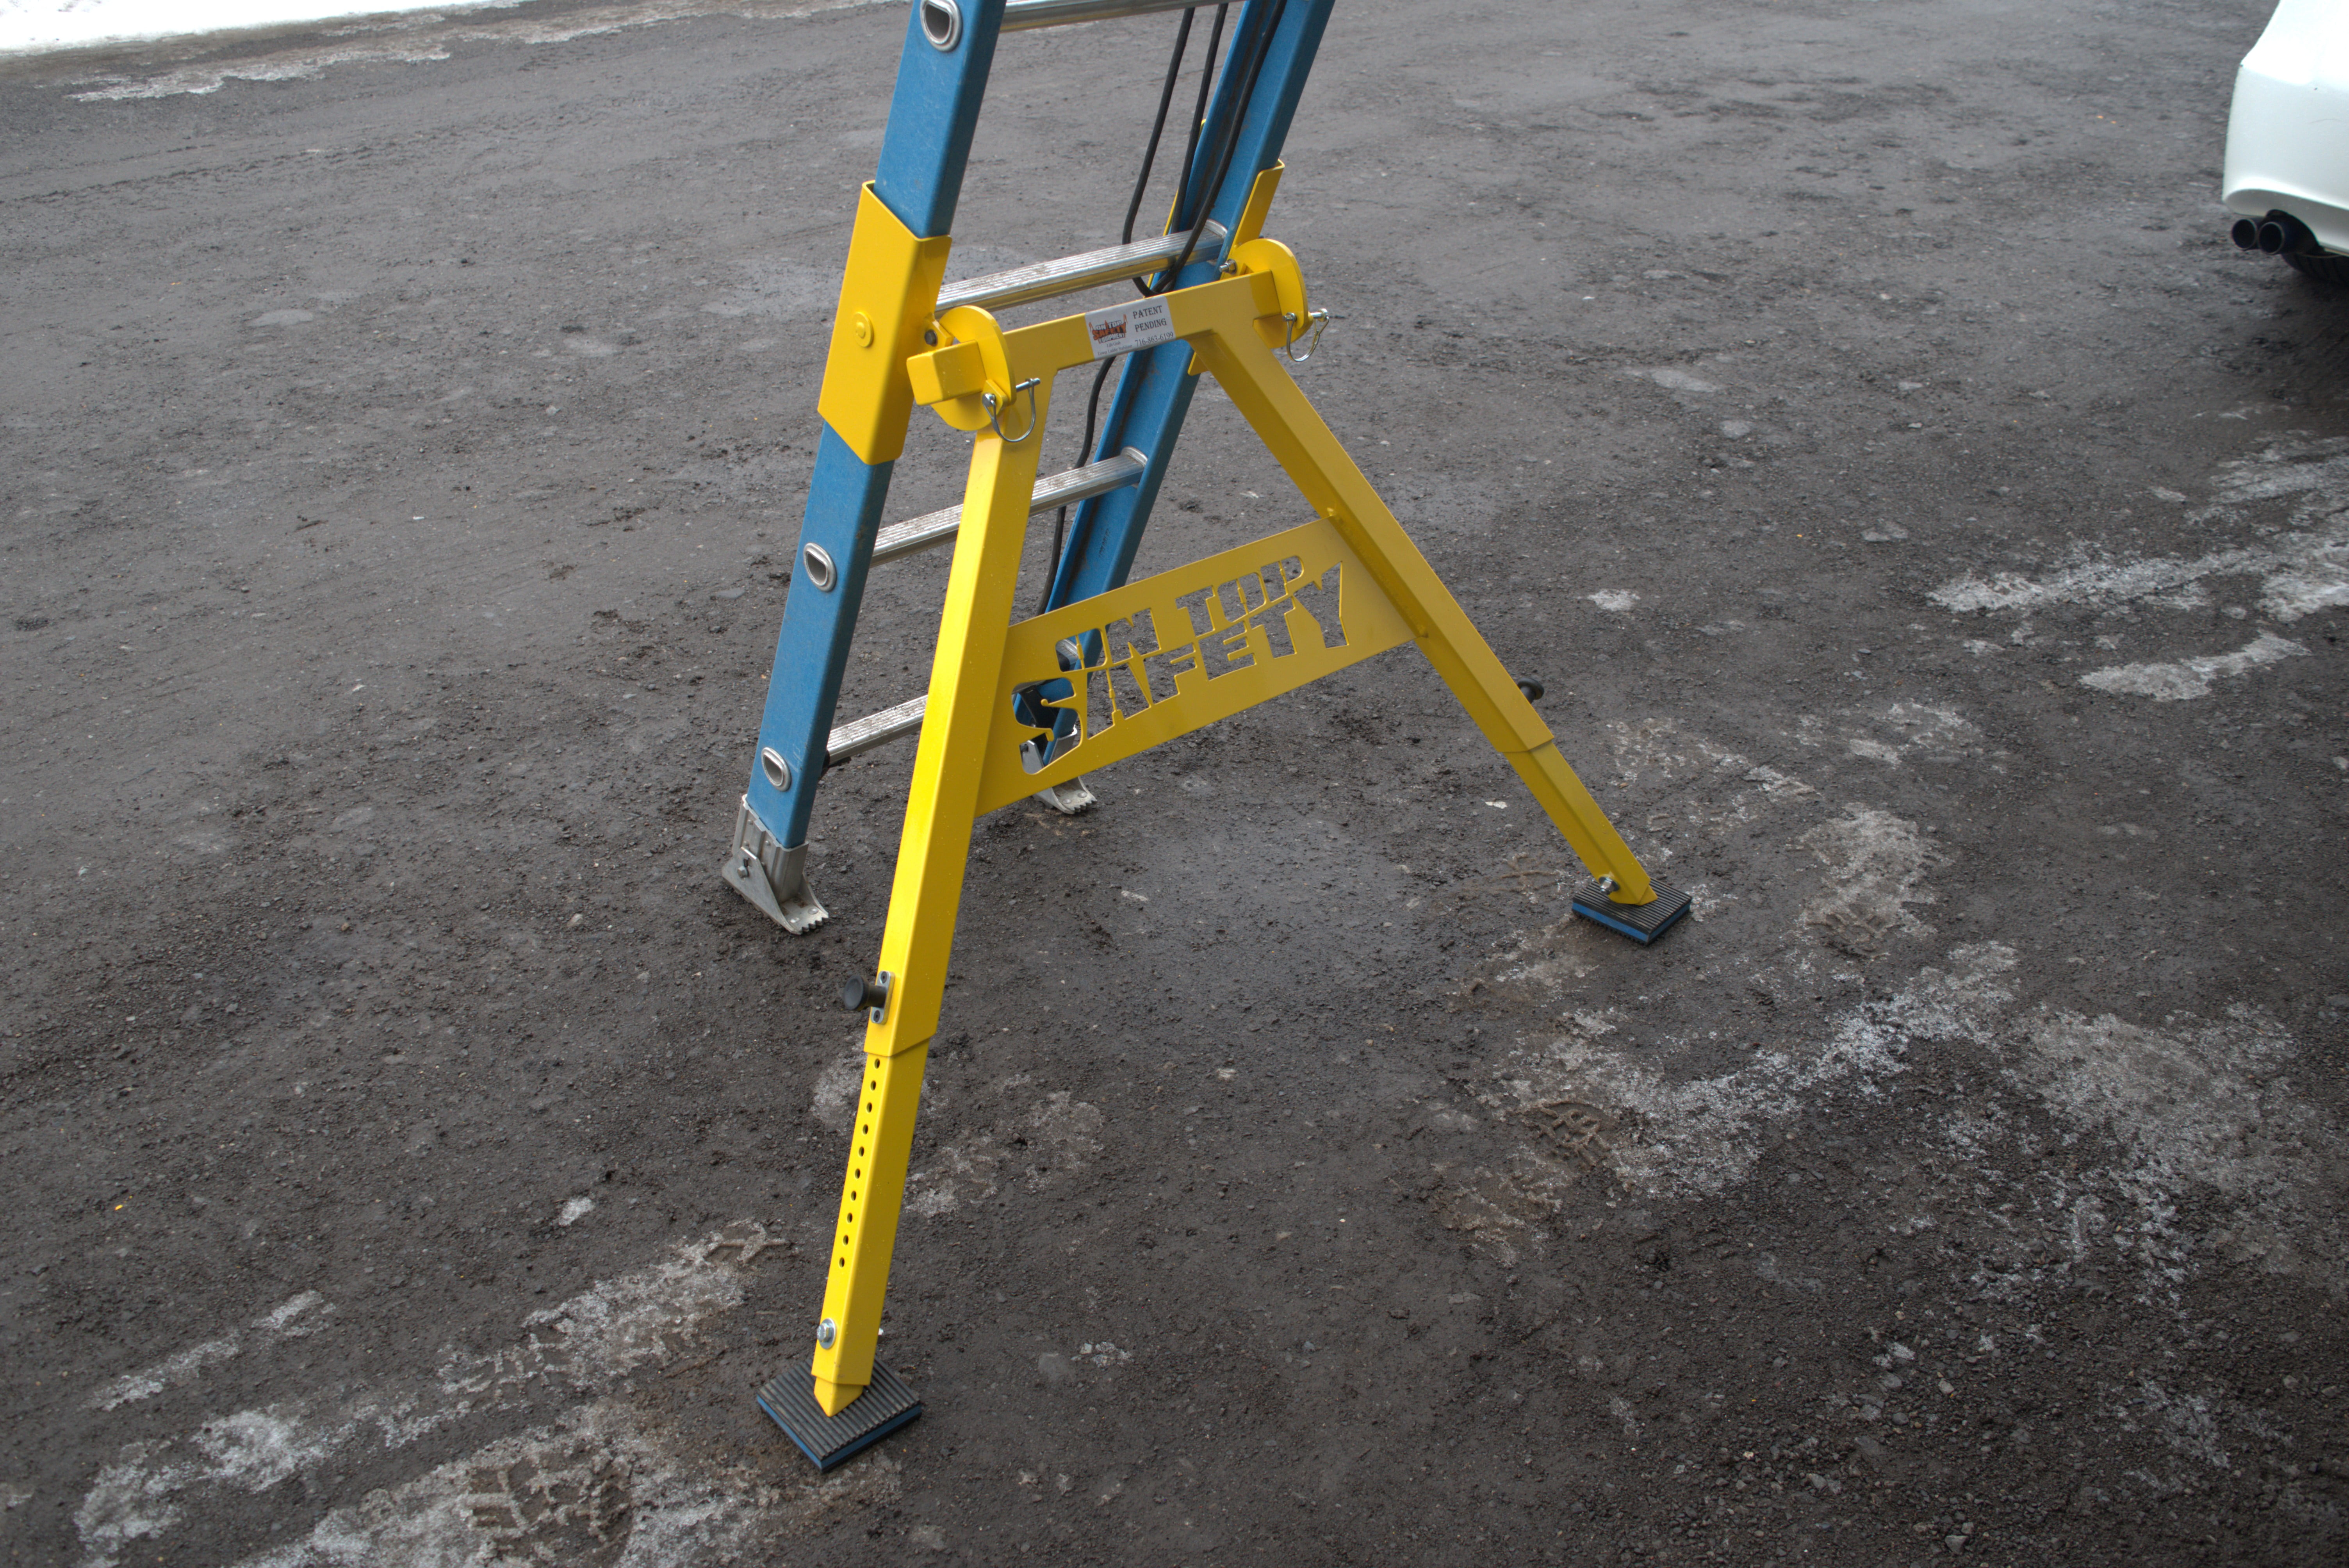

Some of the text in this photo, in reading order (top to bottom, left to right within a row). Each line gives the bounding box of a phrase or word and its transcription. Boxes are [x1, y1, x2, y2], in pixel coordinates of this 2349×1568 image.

[1133, 305, 1162, 319] PATENT
[1092, 321, 1126, 340] SAFETY
[1108, 320, 1122, 329] TOP
[1135, 318, 1167, 332] PENDING
[1098, 333, 1125, 344] EQUIPMENT
[1135, 331, 1174, 347] 716-863-6199
[1055, 555, 1305, 672] ON TOP
[1011, 560, 1350, 775] SAFETY
